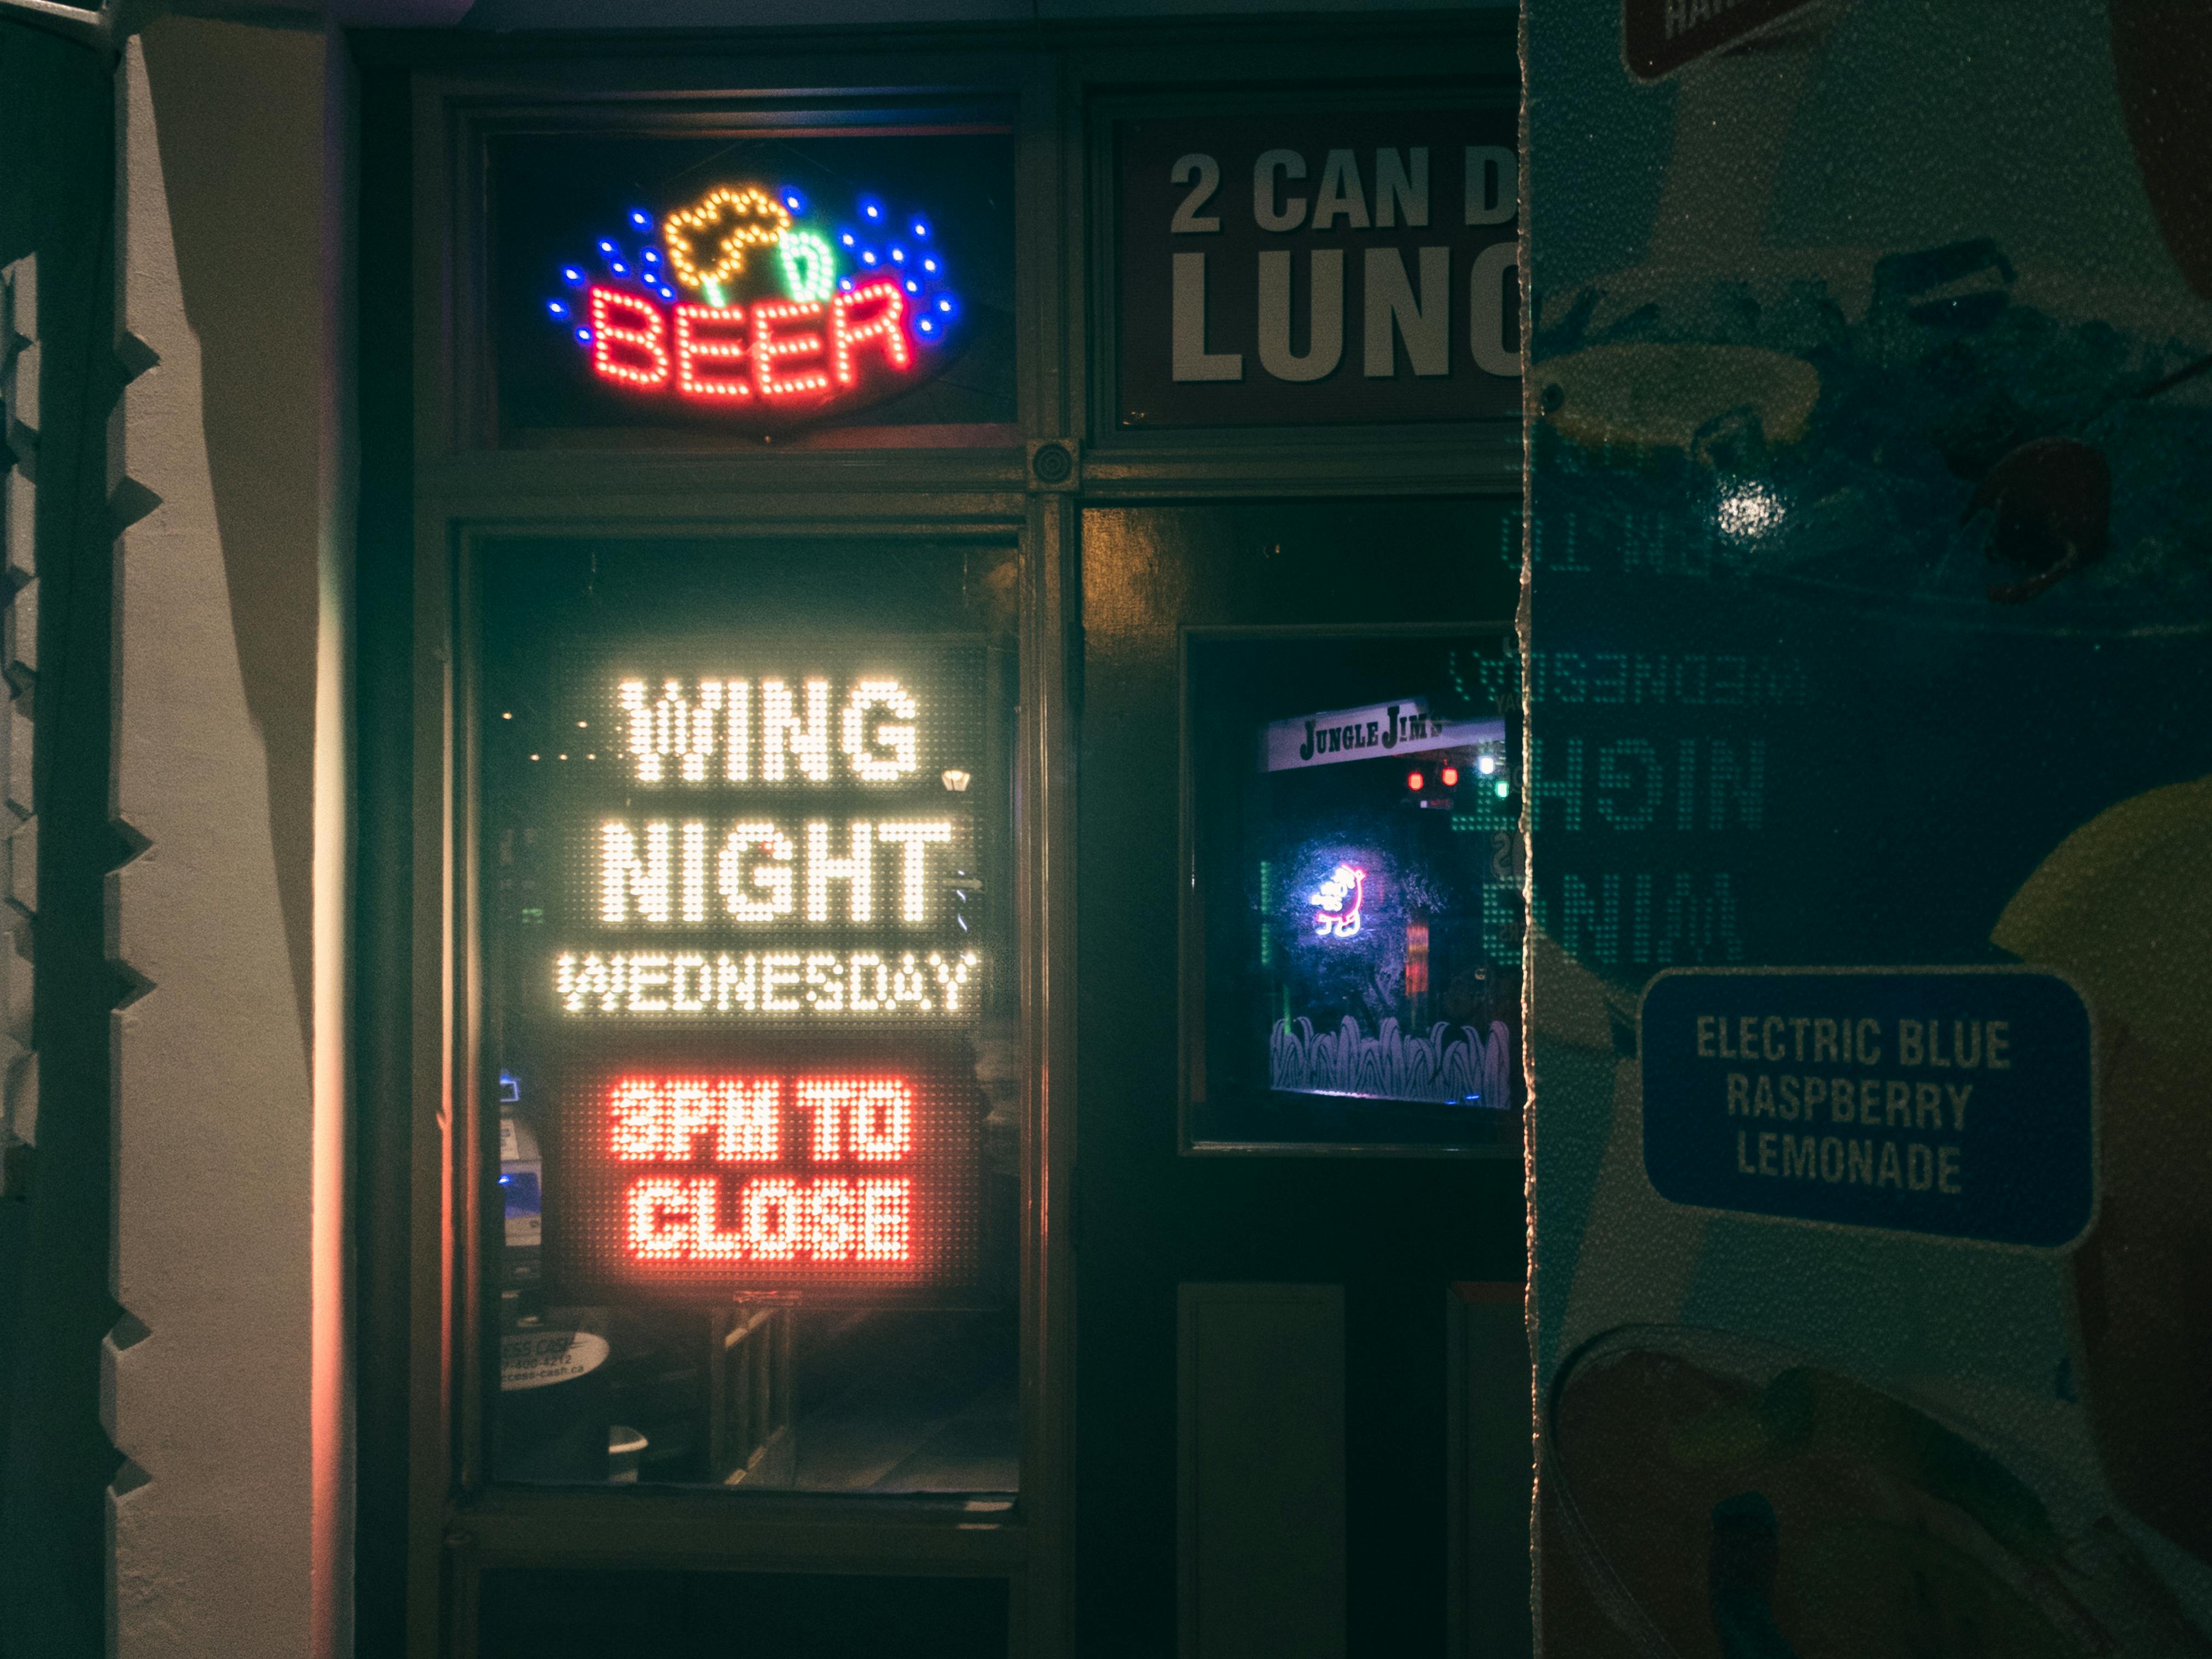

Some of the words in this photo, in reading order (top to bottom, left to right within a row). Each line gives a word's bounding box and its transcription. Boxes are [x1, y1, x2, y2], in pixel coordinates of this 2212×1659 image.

[1170, 154, 1221, 233] 2
[1253, 146, 1429, 233] CAN
[590, 279, 912, 396] BEER
[618, 678, 918, 782] WING
[1300, 719, 1379, 761] JUNGLE
[1381, 705, 1443, 749] JIMS
[601, 822, 952, 923] NIGHT
[556, 952, 979, 1012] WEDNESDAY
[1696, 1014, 1882, 1066] ELECTRIC
[1898, 1018, 2011, 1070] BLUE
[610, 1078, 780, 1163] 3PM
[795, 1078, 912, 1163] TO
[1726, 1071, 1974, 1132] RASPBERRY
[1736, 1130, 1962, 1195] LEMONADE
[627, 1176, 911, 1262] CLOSE
